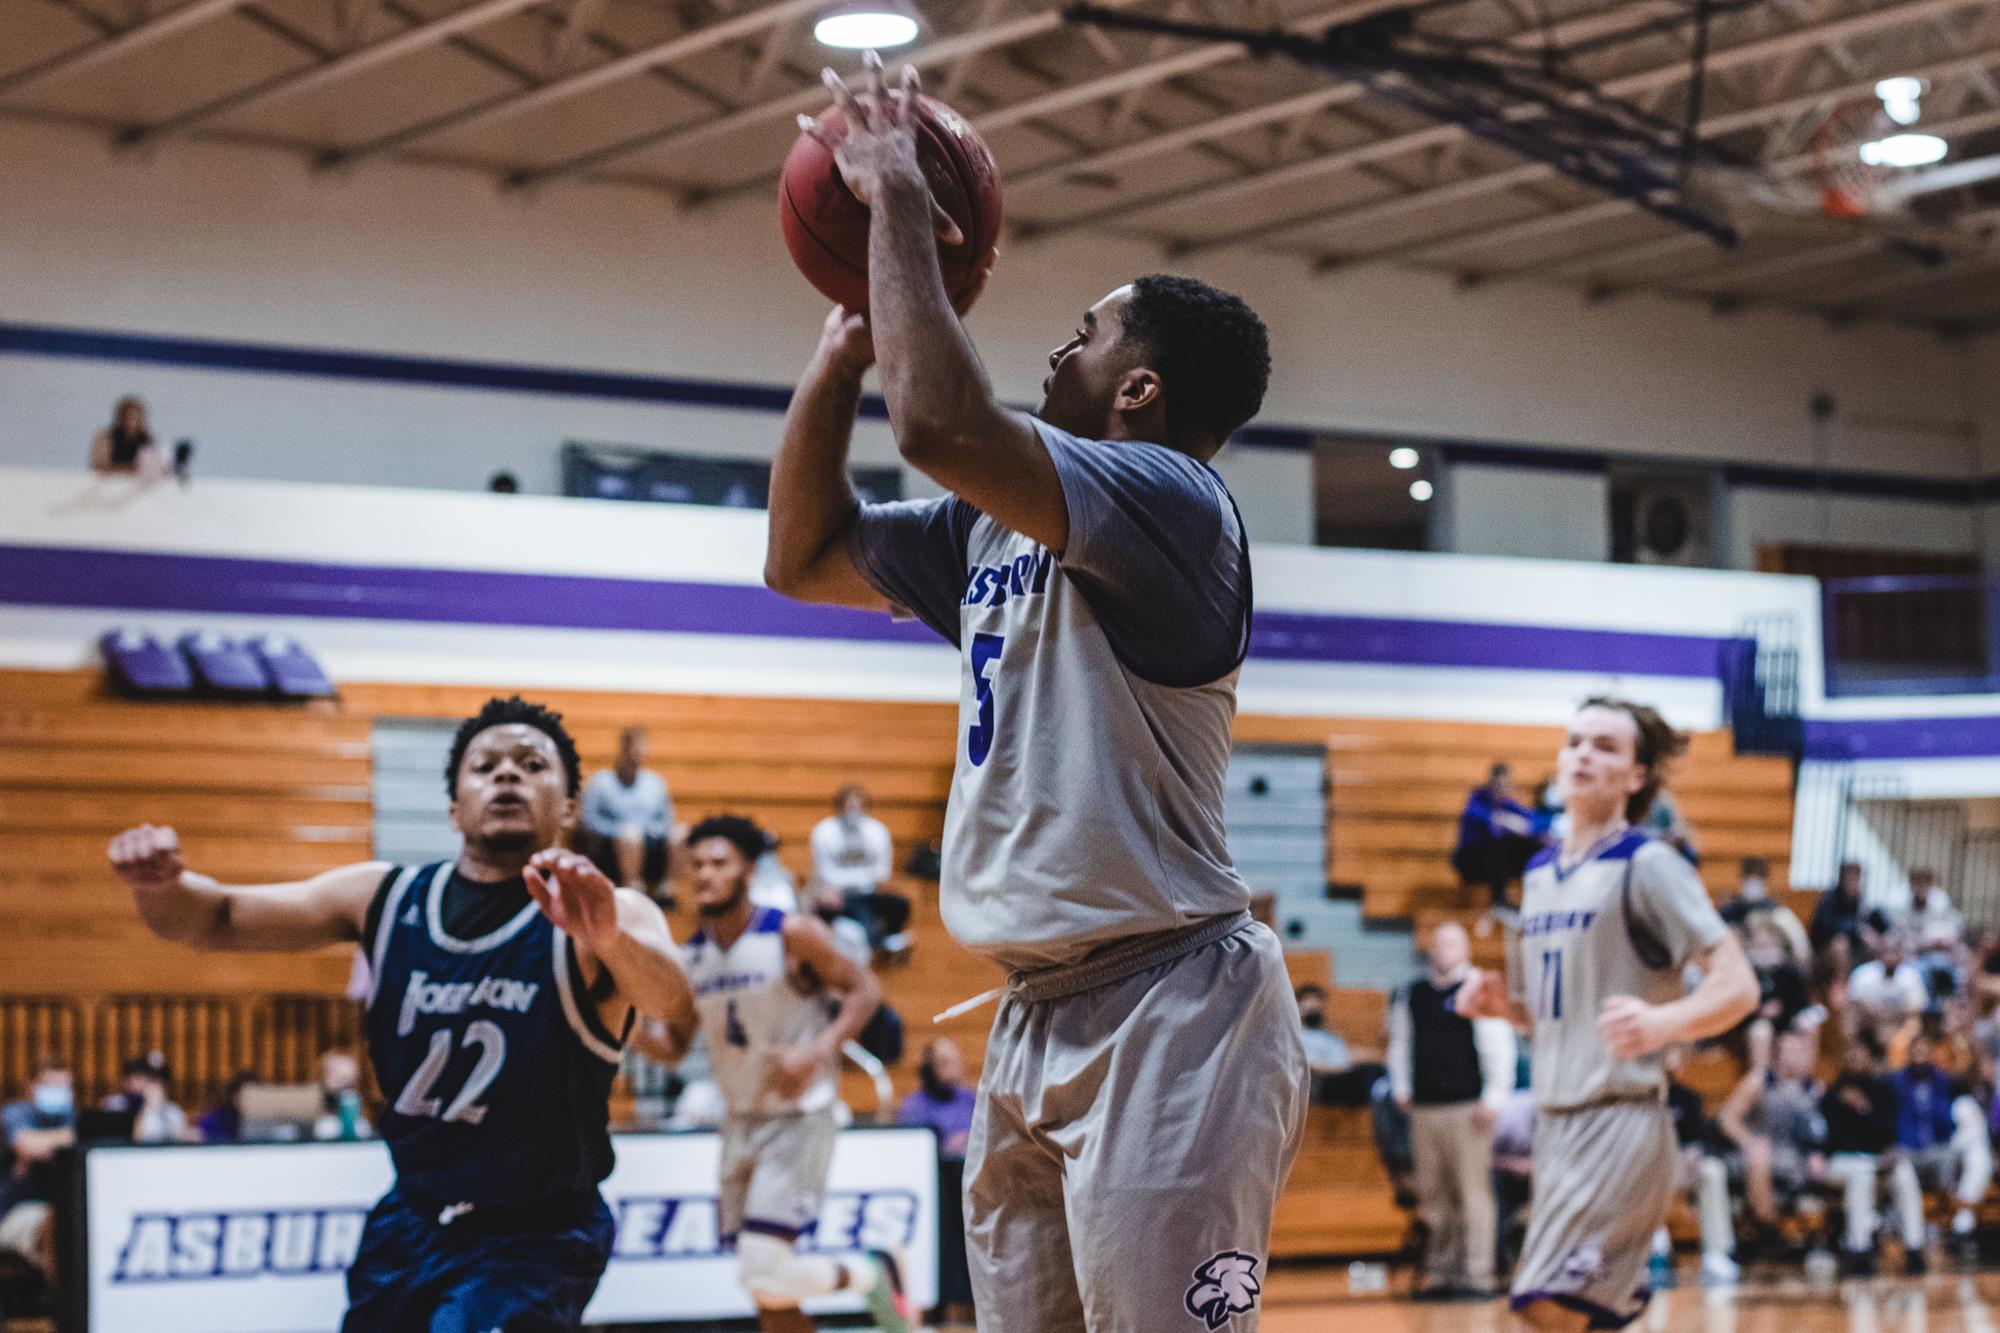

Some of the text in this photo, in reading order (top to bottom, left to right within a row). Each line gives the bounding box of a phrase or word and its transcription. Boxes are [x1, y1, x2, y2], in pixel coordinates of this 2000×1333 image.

[967, 632, 1004, 767] 5
[393, 1018, 507, 1126] 22
[112, 1188, 920, 1283] ASBUR EAES
